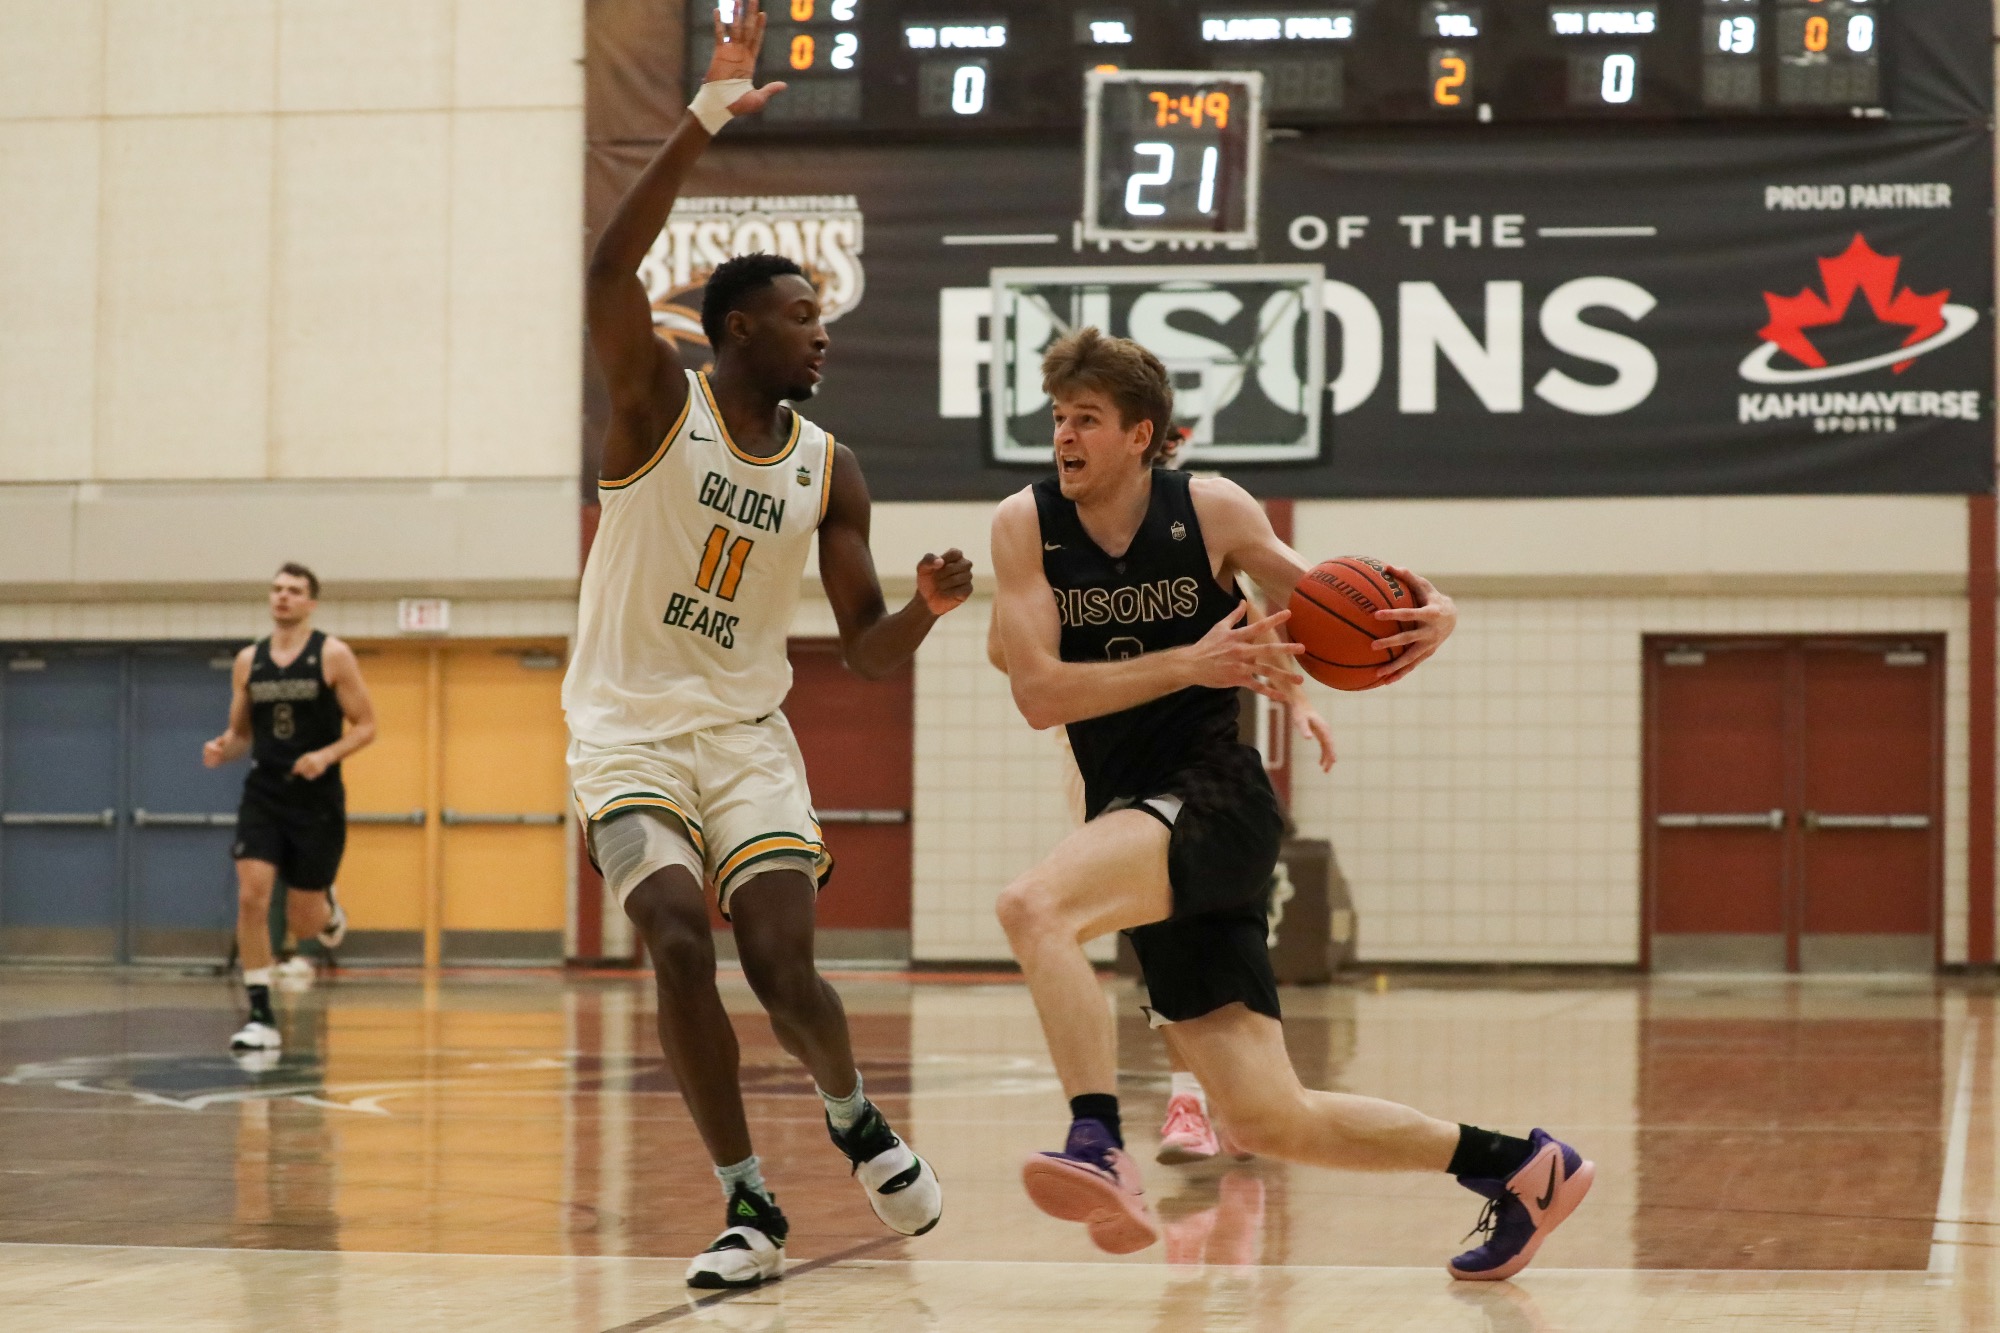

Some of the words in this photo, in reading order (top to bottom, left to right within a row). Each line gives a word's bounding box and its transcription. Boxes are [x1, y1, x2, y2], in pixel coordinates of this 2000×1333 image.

[790, 34, 815, 70] 0
[831, 33, 858, 70] 2
[1719, 17, 1755, 53] 13
[1804, 16, 1828, 52] 0
[1847, 15, 1873, 52] 0
[952, 66, 985, 114] 0
[1434, 58, 1466, 105] 2
[1601, 55, 1634, 103] 0
[1149, 91, 1230, 128] 7:49
[1125, 143, 1218, 216] 21
[1765, 185, 1845, 211] PROUD
[1850, 183, 1952, 209] PARTNER
[1288, 215, 1370, 250] OF
[1398, 214, 1525, 248] THE
[1738, 391, 1980, 424] KAHUNAVERSE
[1813, 416, 1897, 433] SPORTS
[698, 471, 785, 533] GOLDEN
[695, 523, 754, 602] 11
[663, 592, 740, 650] BEARS
